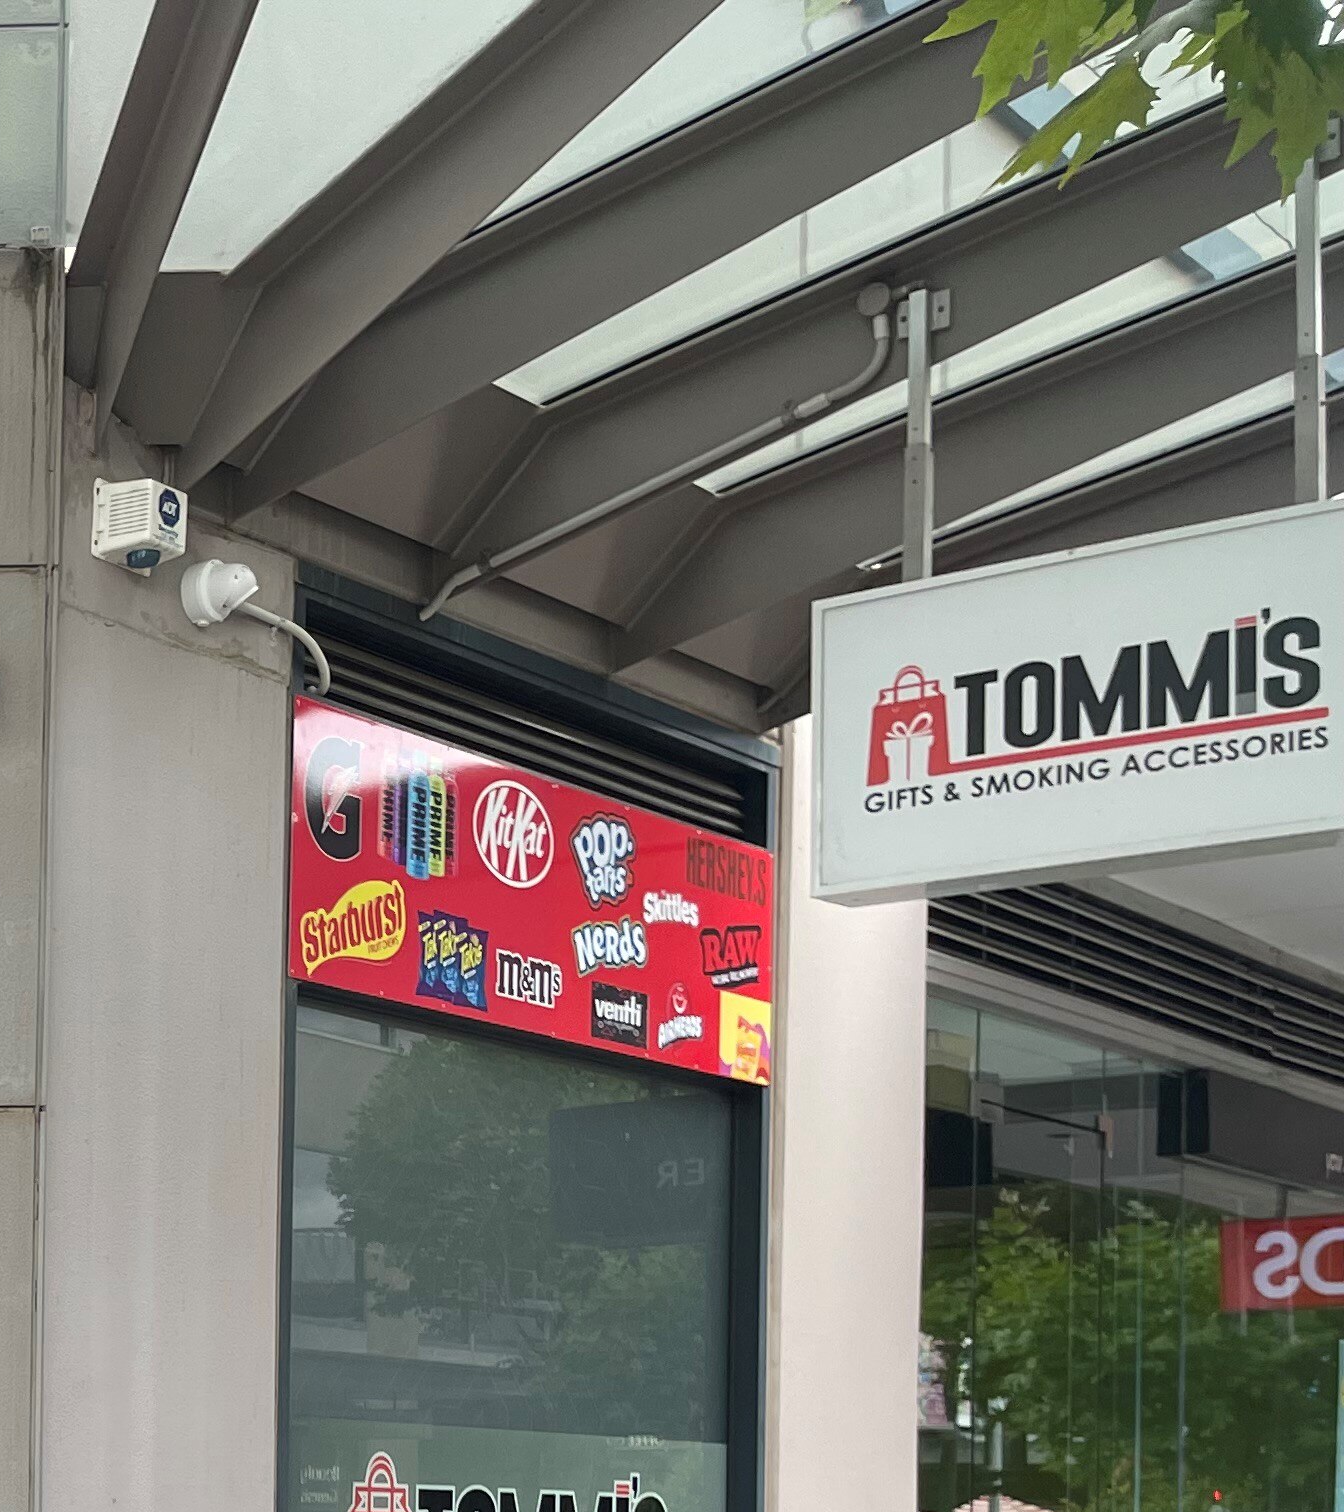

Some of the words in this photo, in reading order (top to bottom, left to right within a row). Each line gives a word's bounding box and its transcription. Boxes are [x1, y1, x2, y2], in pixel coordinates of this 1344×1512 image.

[954, 608, 1321, 757] TOMMI'S
[864, 784, 934, 814] GIFTS
[944, 782, 961, 802] &
[972, 757, 1111, 798] SMOKING
[1121, 727, 1329, 776] ACCESSORIES
[412, 786, 427, 865] PRIME
[429, 790, 443, 864] PRIME
[302, 884, 403, 964] Starburst
[643, 892, 699, 927] Skittles
[702, 932, 759, 972] RAW
